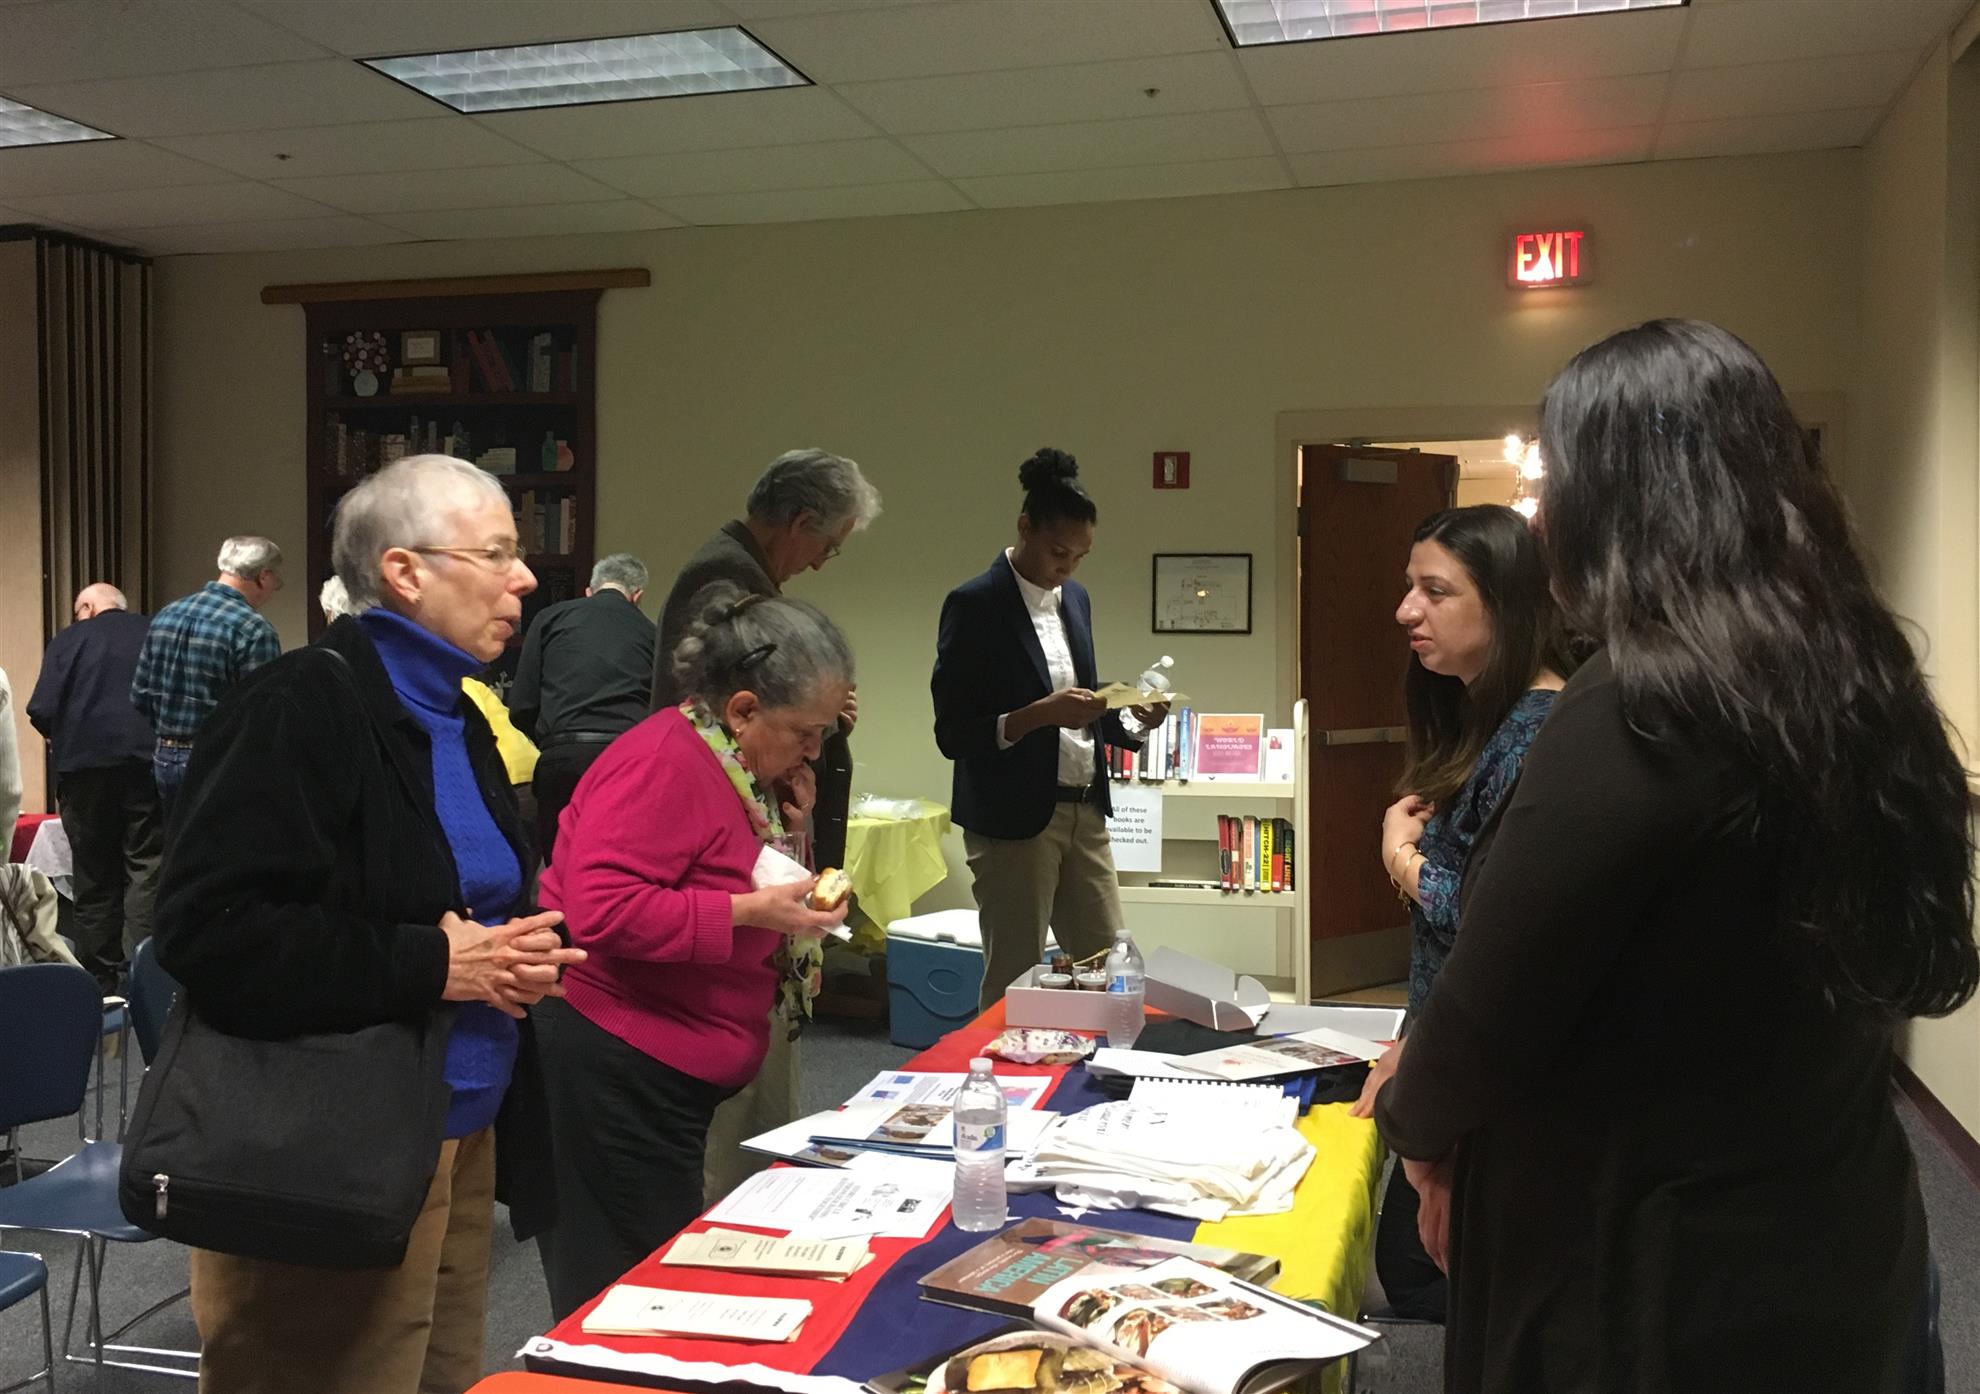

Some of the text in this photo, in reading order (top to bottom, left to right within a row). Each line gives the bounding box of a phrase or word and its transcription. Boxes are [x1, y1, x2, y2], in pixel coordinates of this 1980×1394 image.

[1516, 231, 1584, 281] EXIT
[975, 1251, 1051, 1293] AMERICA
[1026, 1257, 1083, 1285] LATIN
